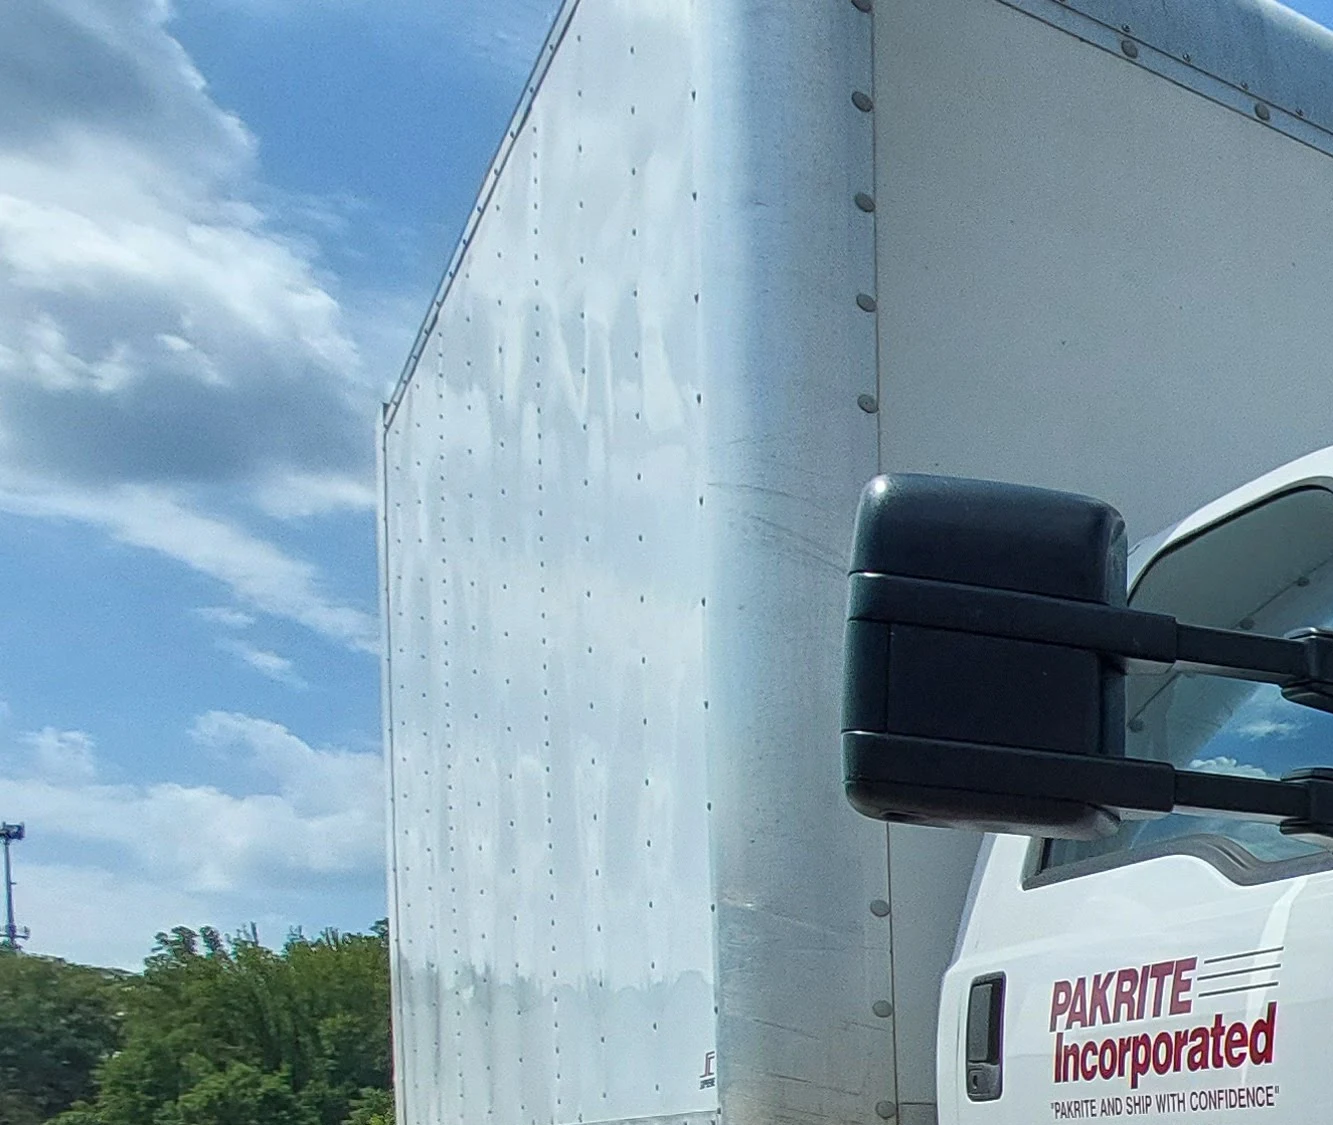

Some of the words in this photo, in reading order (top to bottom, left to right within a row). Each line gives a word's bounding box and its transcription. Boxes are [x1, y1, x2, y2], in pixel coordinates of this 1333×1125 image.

[1049, 956, 1198, 1032] PAKRITE
[1054, 1001, 1278, 1089] Incorporated
[1100, 1096, 1123, 1117] AND
[1126, 1094, 1152, 1116] SHIP
[1155, 1092, 1187, 1114] WITH
